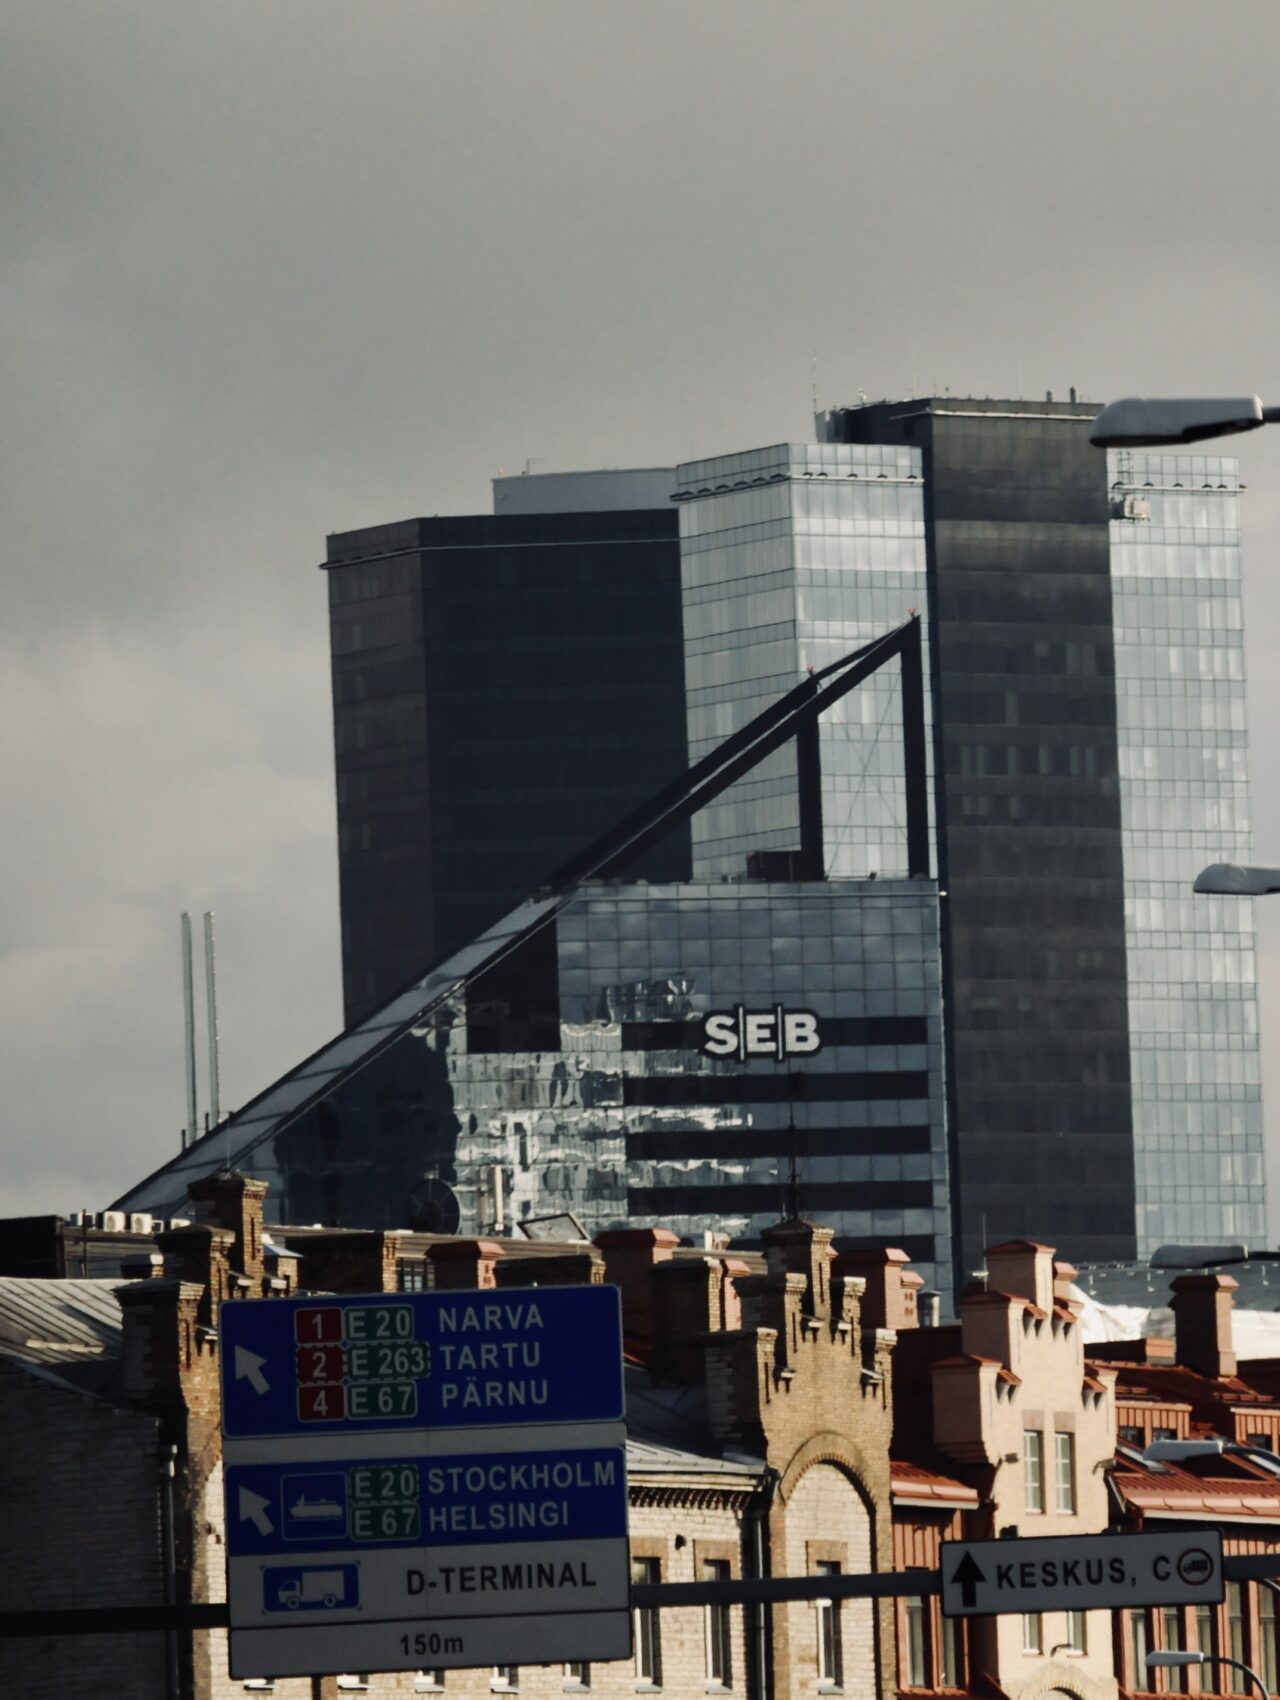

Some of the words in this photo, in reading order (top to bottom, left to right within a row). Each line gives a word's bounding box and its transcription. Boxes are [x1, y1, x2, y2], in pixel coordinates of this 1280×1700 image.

[704, 1006, 821, 1061] SEB
[311, 1313, 323, 1340] 1
[350, 1311, 366, 1338] E
[376, 1310, 411, 1337] 20
[439, 1304, 544, 1333] NARVA
[312, 1352, 327, 1378] 2
[352, 1349, 369, 1376] E
[378, 1347, 425, 1374] 263
[440, 1342, 540, 1371] TARTU
[312, 1390, 329, 1416] 4
[351, 1388, 369, 1414] E
[378, 1386, 413, 1412] 67
[442, 1376, 548, 1408] PÄRNU
[354, 1472, 372, 1498] E
[380, 1470, 416, 1497] 20
[428, 1461, 615, 1494] STOCKHOLM
[355, 1510, 373, 1536] E
[382, 1508, 417, 1534] 67
[429, 1501, 569, 1532] HELSINGI
[406, 1562, 597, 1595] D-TERMINAL
[996, 1557, 1137, 1589] KESKUS,
[1153, 1555, 1171, 1581] C
[400, 1633, 464, 1656] 150m
